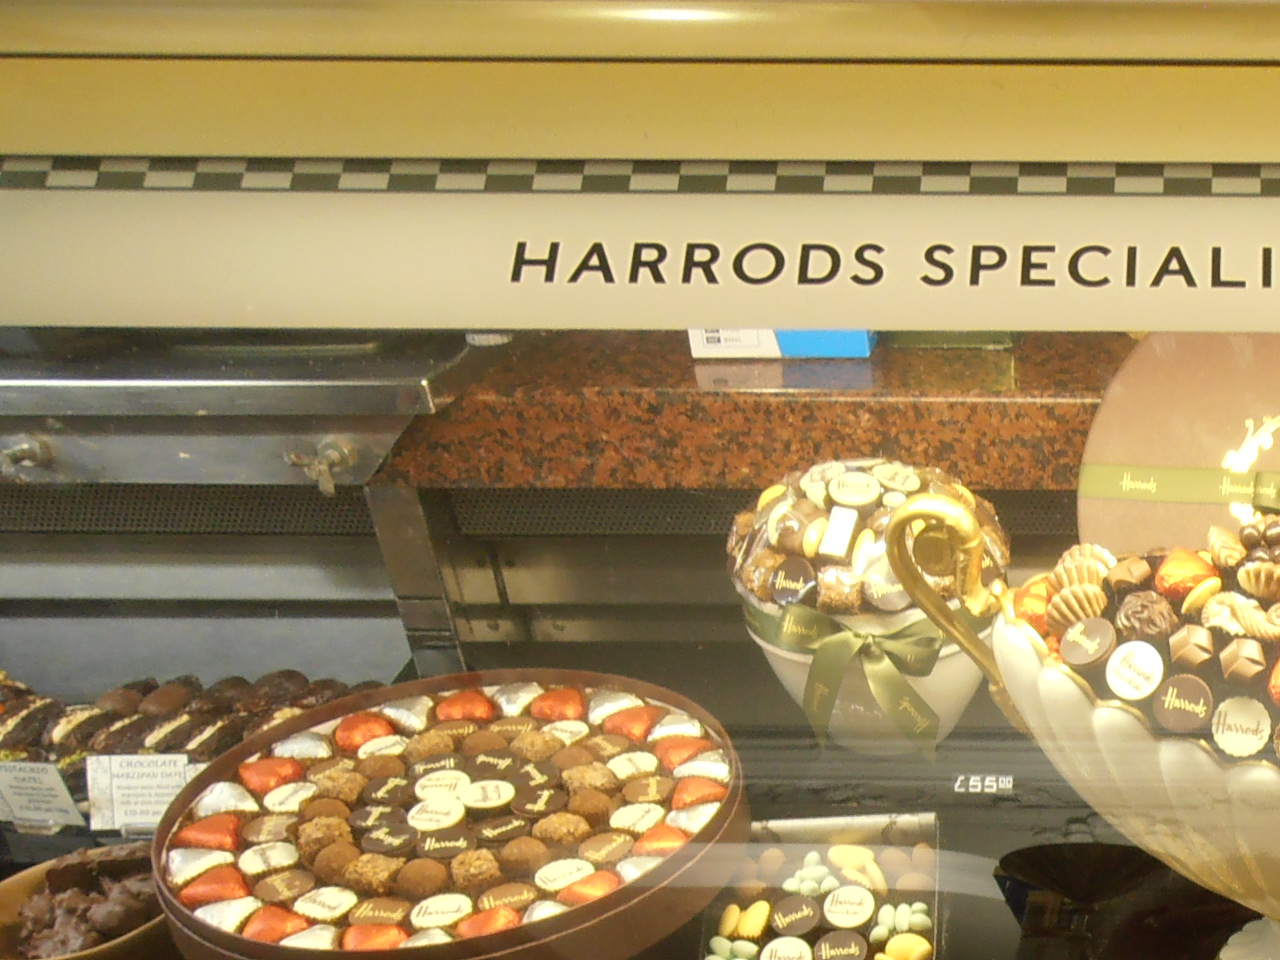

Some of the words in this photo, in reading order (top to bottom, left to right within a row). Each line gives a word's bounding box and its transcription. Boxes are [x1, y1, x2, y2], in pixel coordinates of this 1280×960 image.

[510, 240, 886, 287] HARRODS
[1161, 685, 1207, 718] Harrods
[1215, 710, 1264, 741] Harrods
[424, 837, 468, 851] Harrods
[774, 904, 813, 929] Harrods
[818, 942, 860, 960] Harrods
